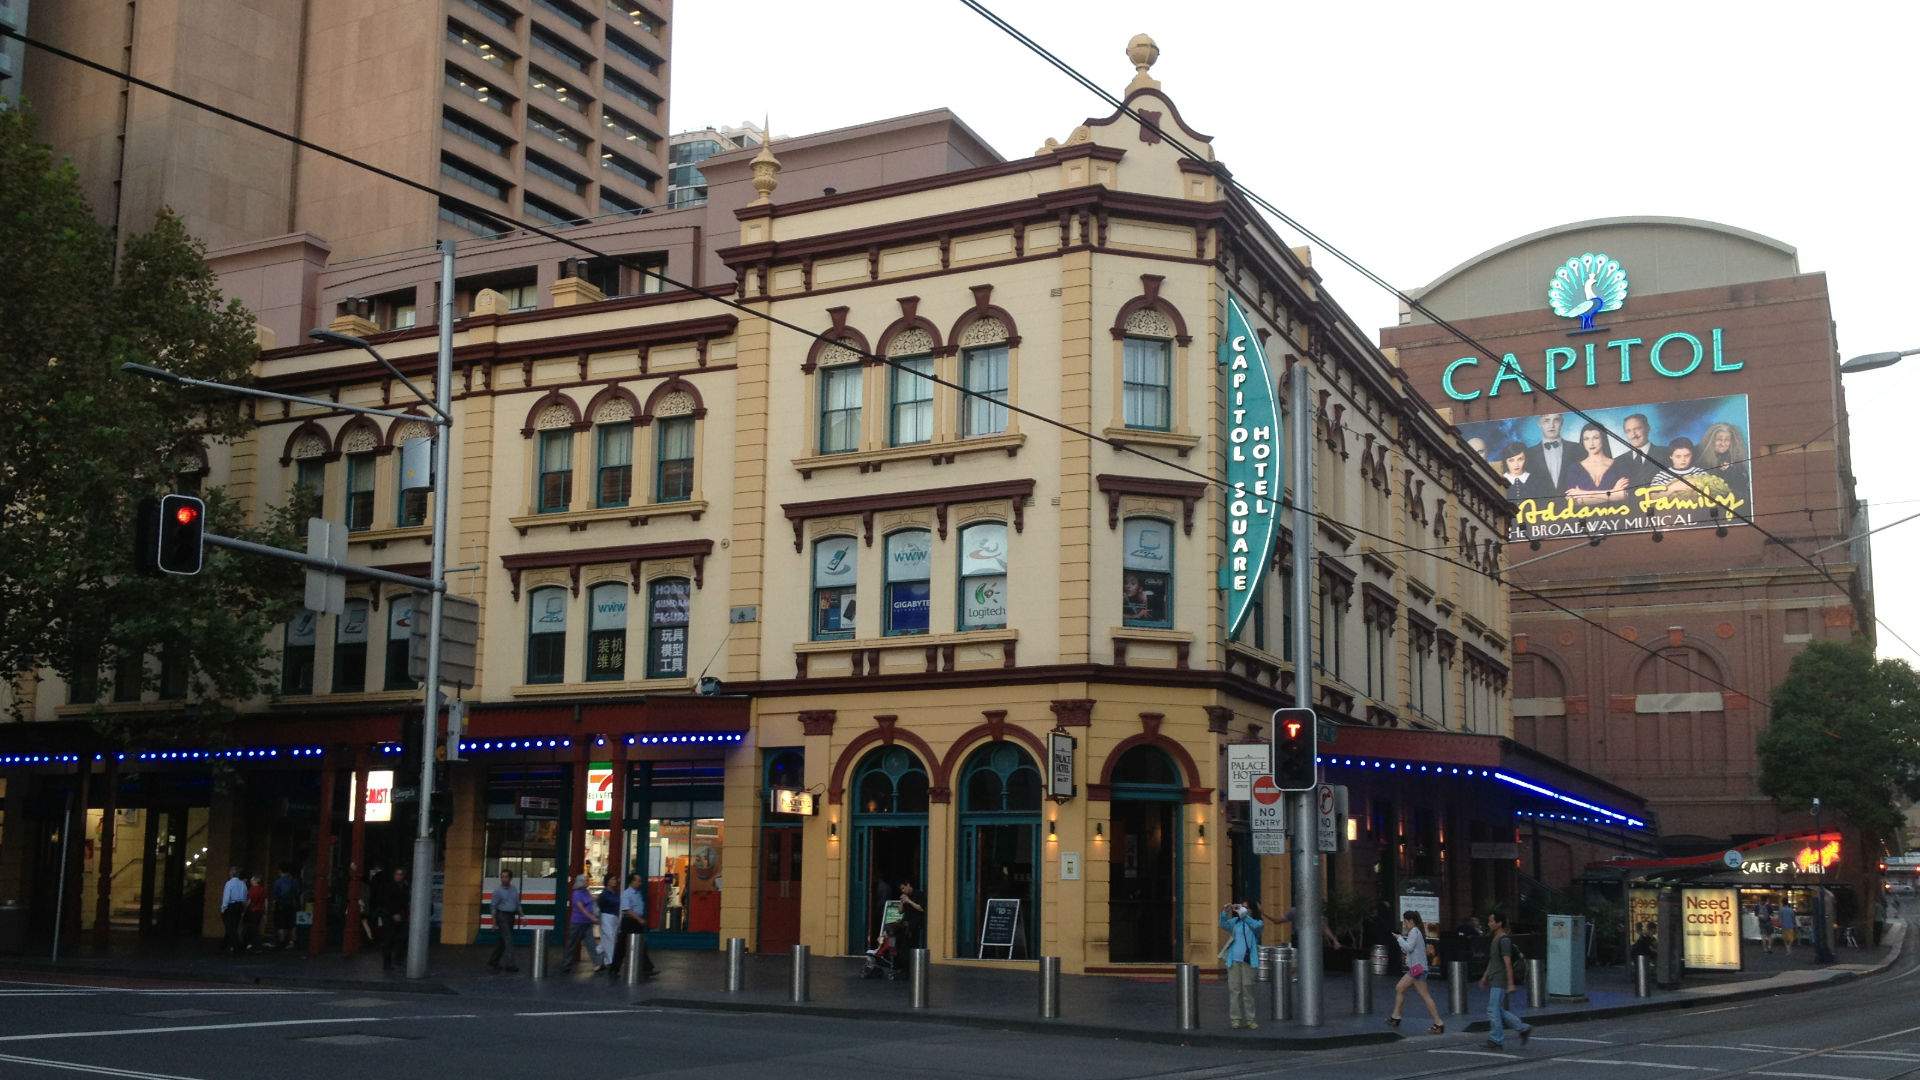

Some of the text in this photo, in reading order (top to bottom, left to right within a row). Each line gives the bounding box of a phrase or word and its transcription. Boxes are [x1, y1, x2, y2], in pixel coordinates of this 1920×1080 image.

[1441, 327, 1745, 401] CAPITOL
[1230, 335, 1249, 591] CAPITOL SQUARE
[1253, 426, 1270, 514] HOTEL
[1516, 485, 1744, 524] Addams Family
[1624, 514, 1697, 529] MUSICAL
[893, 600, 931, 609] GIGABYTE
[968, 606, 1006, 619] Logitech
[1231, 761, 1267, 770] PALACE
[1259, 808, 1276, 817] NO
[1254, 819, 1280, 827] ENTRY
[1321, 818, 1331, 828] NO
[1741, 861, 1771, 875] CAFE
[1686, 896, 1730, 910] Need
[1686, 911, 1732, 925] cash?
